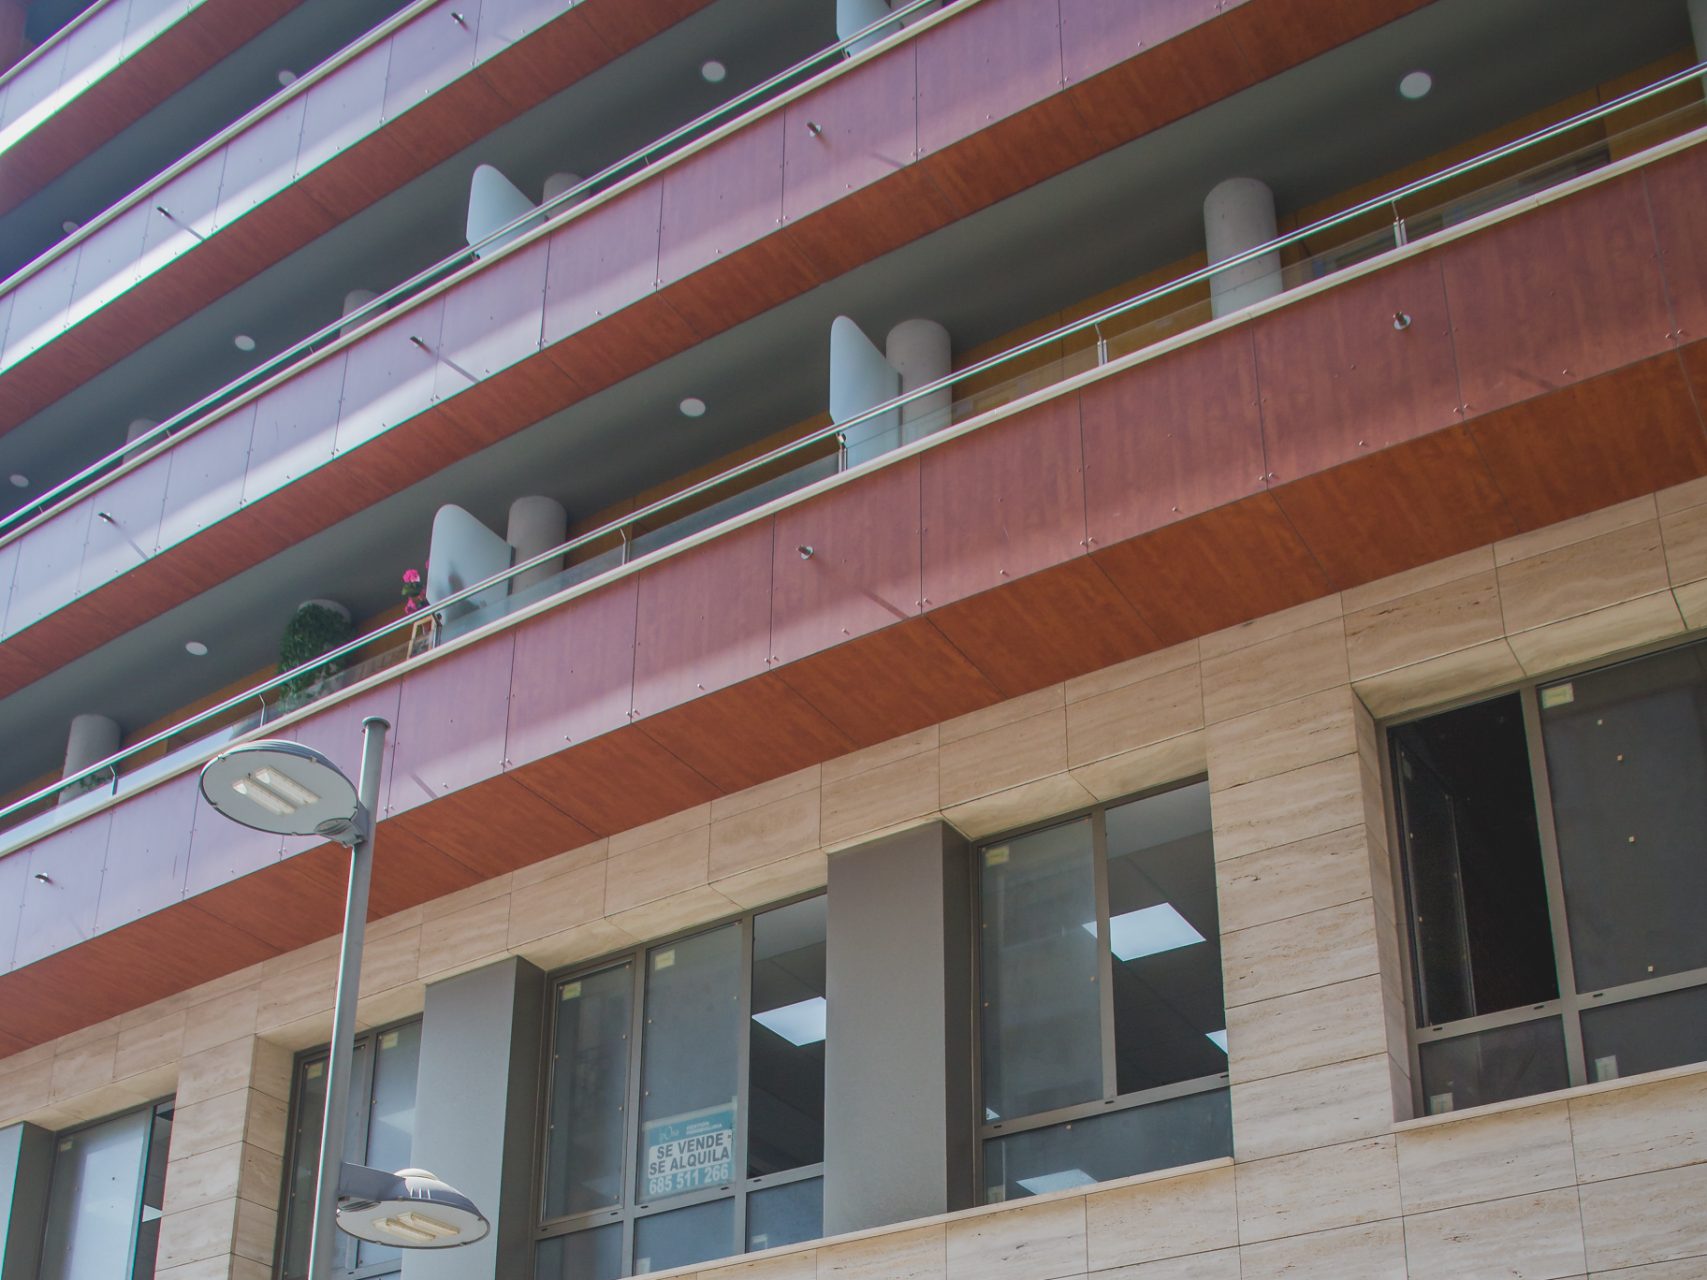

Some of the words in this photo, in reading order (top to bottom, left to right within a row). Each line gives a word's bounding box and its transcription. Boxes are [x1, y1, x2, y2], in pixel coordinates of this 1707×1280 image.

[656, 1144, 673, 1159] SE
[678, 1132, 724, 1154] VENDE
[649, 1160, 666, 1176] SE
[669, 1146, 730, 1171] ALQUILA
[649, 1175, 673, 1195] 685
[676, 1170, 700, 1189] 511
[704, 1163, 729, 1183] 266
